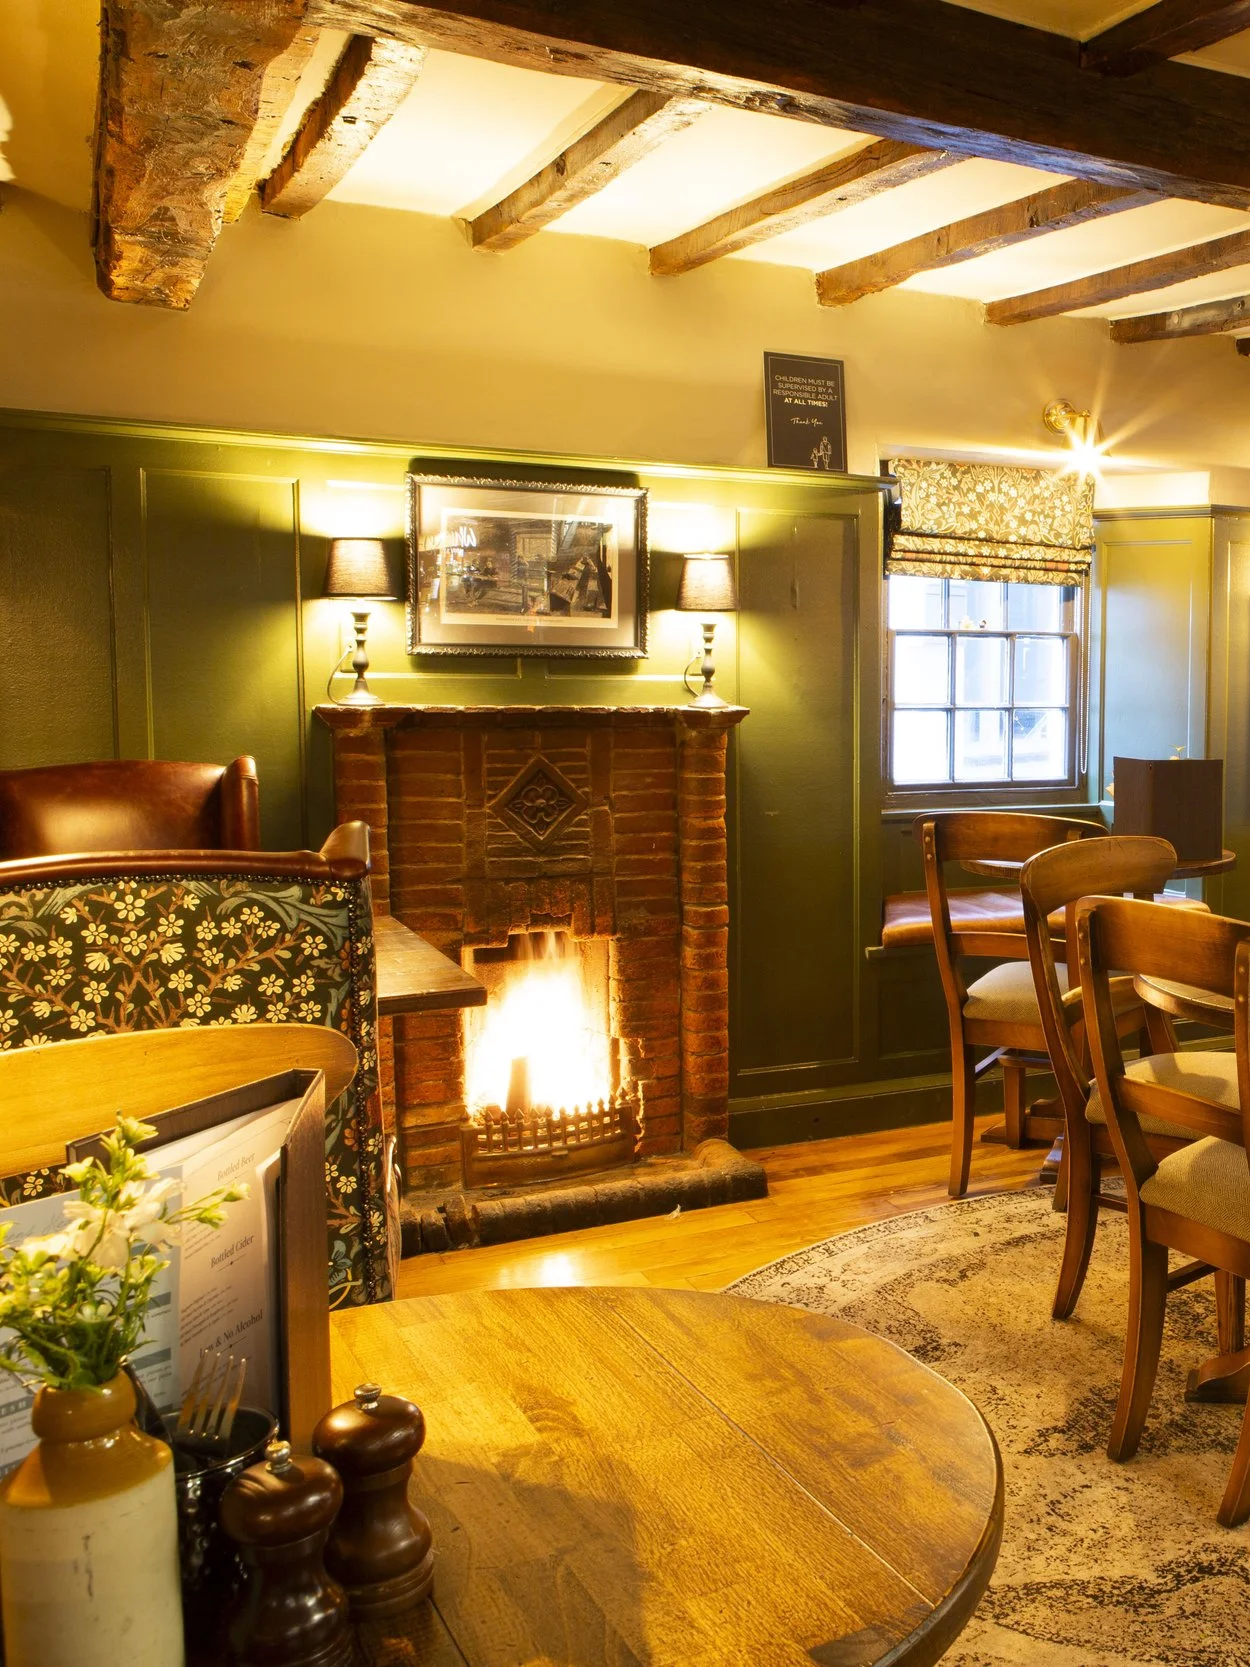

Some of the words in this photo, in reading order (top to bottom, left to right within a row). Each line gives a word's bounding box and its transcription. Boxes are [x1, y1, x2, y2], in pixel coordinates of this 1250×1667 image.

[774, 375, 807, 383] CHILDREN
[808, 378, 825, 386] MUST
[778, 383, 816, 391] SUPERVISED
[773, 389, 816, 400] RESPONSIBLE
[817, 393, 838, 401] ADULT
[790, 417, 811, 425] Thank
[811, 418, 823, 428] You
[210, 1242, 236, 1269] Bottled
[234, 1234, 255, 1254] Cider
[215, 1335, 223, 1348] &
[223, 1329, 235, 1341] No
[235, 1308, 264, 1334] Alcohol
